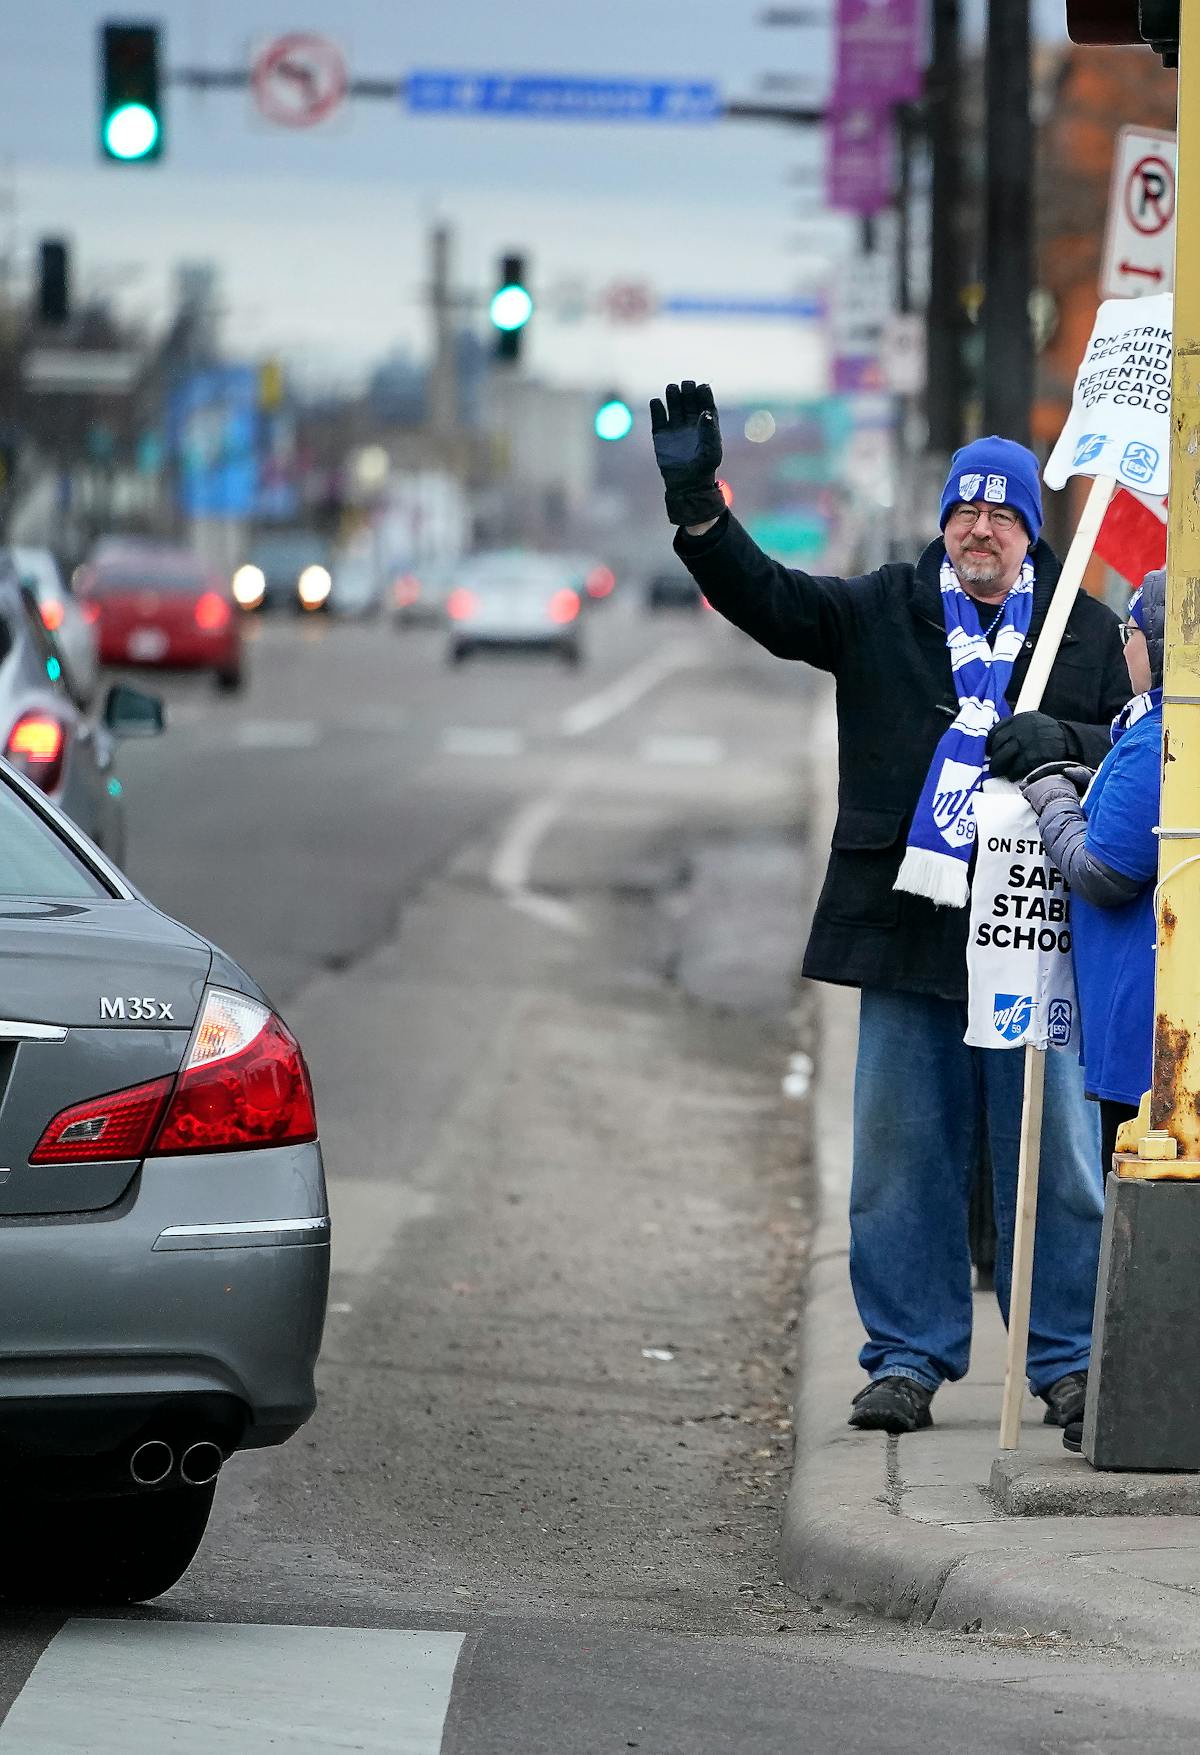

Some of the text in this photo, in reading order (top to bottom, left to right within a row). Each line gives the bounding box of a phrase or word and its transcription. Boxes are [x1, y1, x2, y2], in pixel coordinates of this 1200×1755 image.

[1094, 326, 1173, 349] ON STRIK
[1123, 354, 1168, 370] AND
[1078, 367, 1171, 391] RETENTIO
[1083, 380, 1171, 402] EDUCATO
[1086, 393, 1107, 408] OF
[987, 837, 1012, 854] ON
[976, 922, 1072, 954] SCHOO
[99, 997, 174, 1020] M35x
